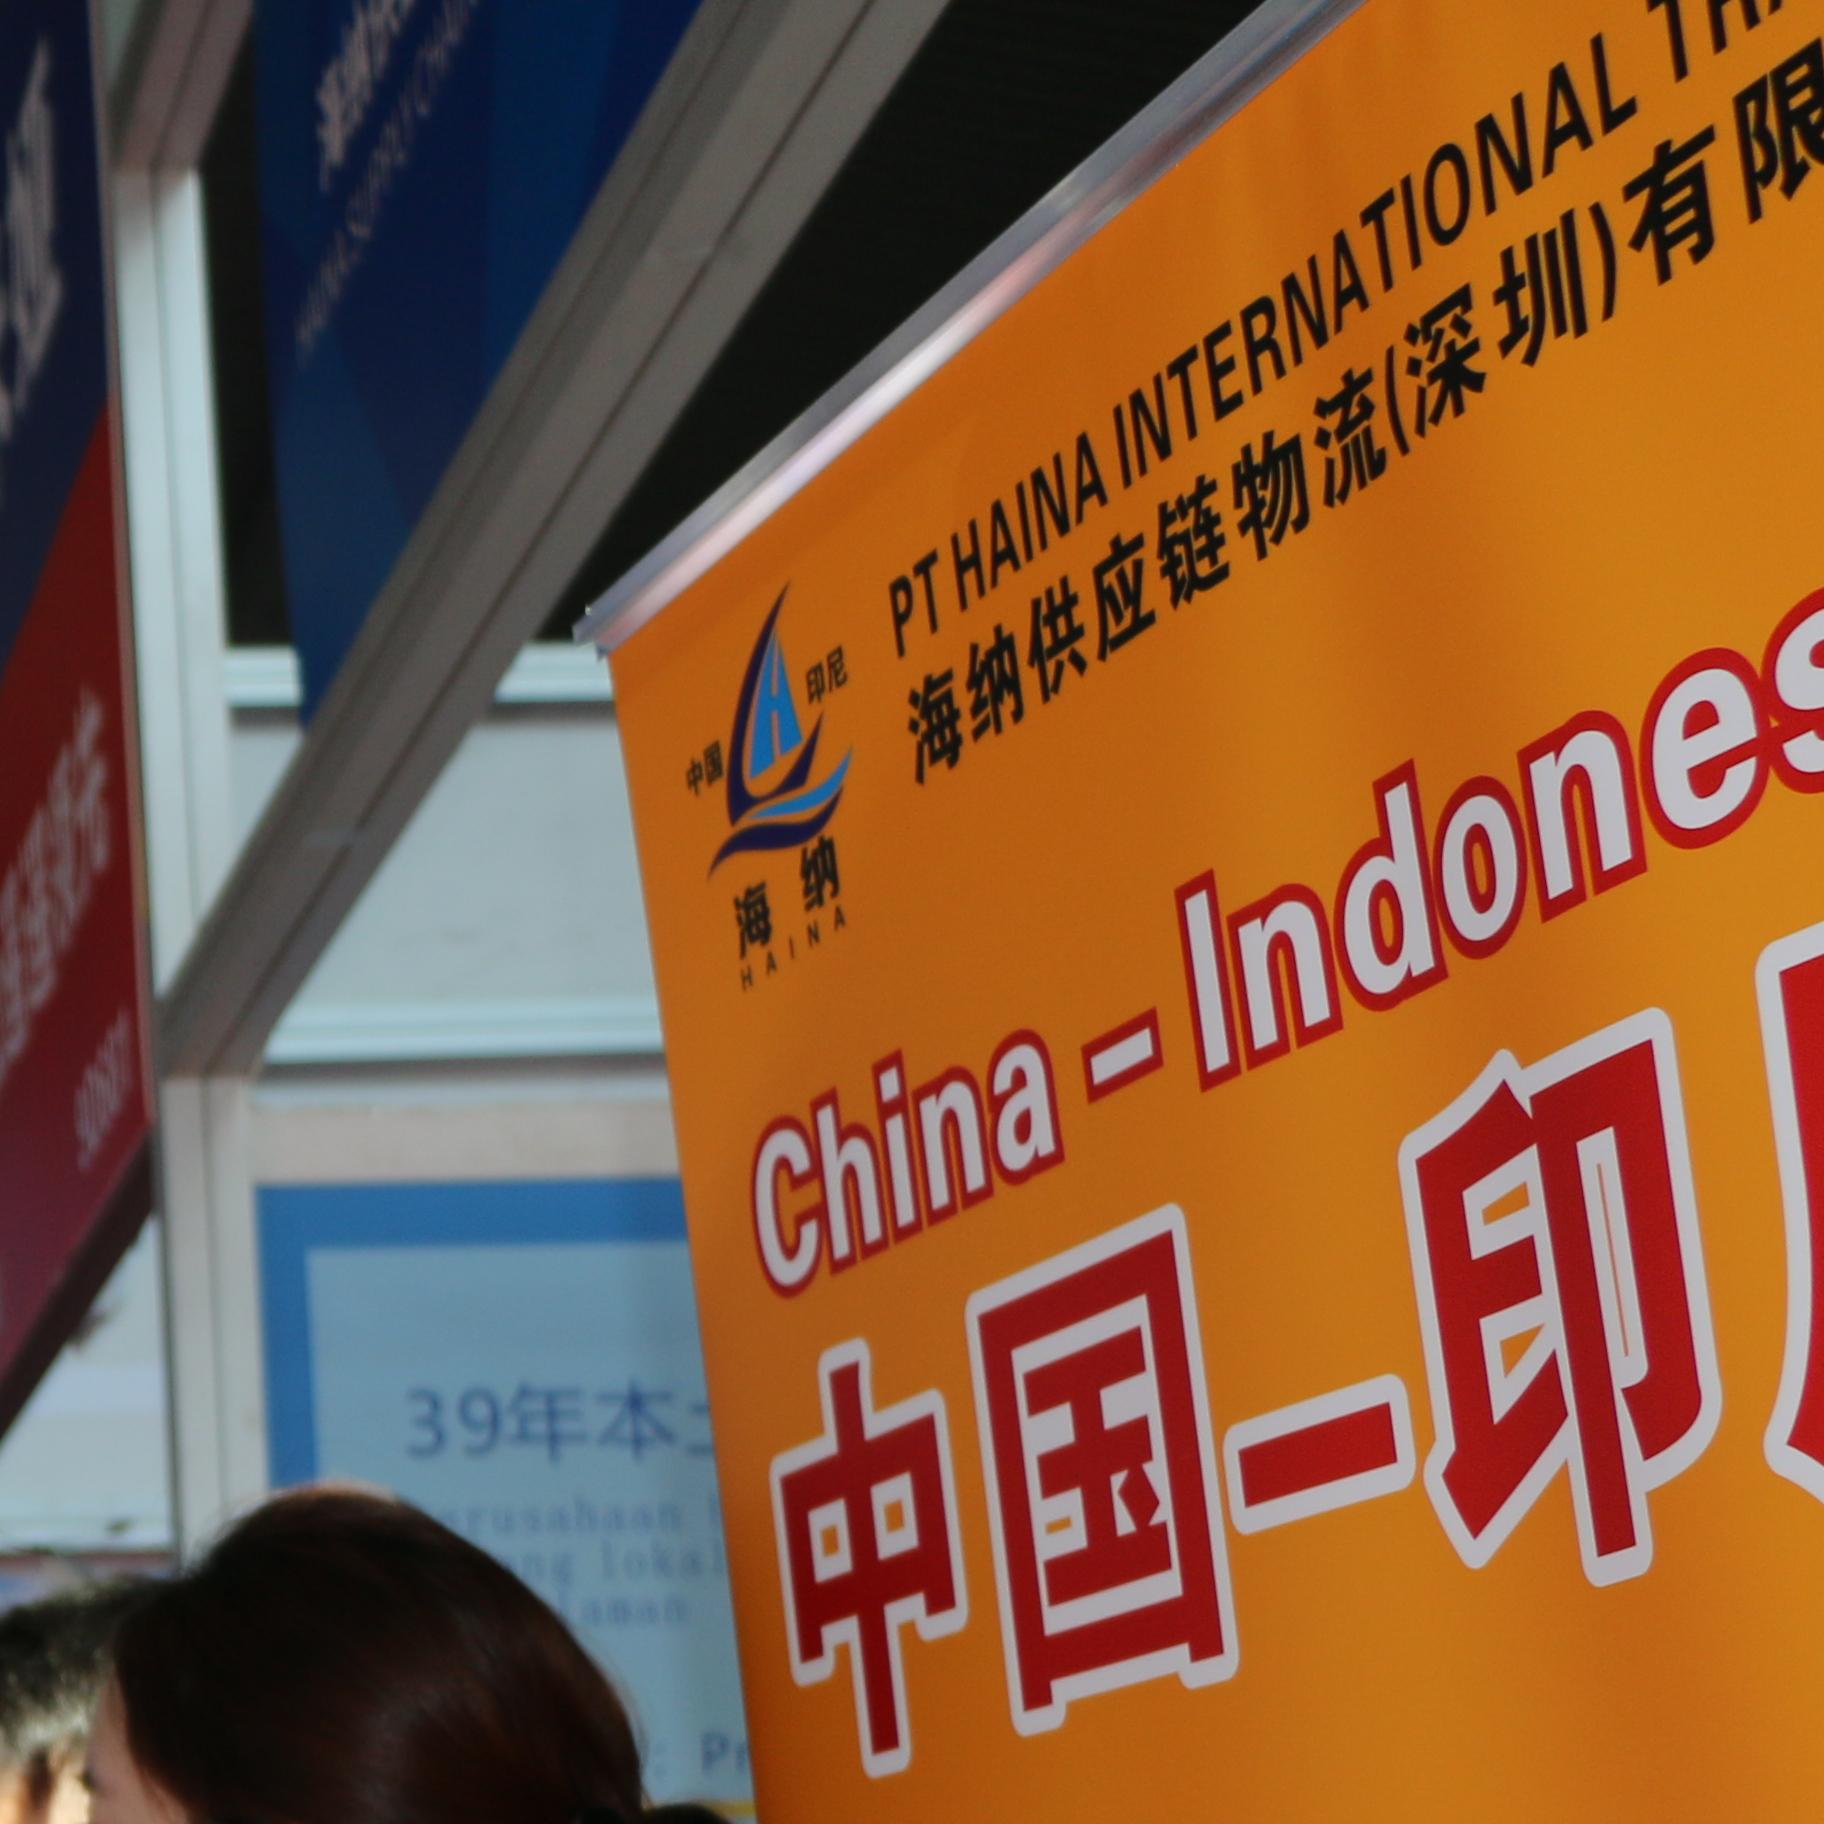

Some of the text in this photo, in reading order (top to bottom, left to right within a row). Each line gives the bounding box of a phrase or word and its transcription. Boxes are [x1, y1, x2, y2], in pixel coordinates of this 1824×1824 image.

[887, 552, 940, 659] PT
[952, 432, 1109, 616] HAINA
[1117, 32, 1638, 489] INTERNATIONAL
[804, 643, 848, 705] 印尼
[685, 739, 725, 797] 中国
[732, 834, 842, 960] 海纳
[739, 903, 847, 992] HAINA
